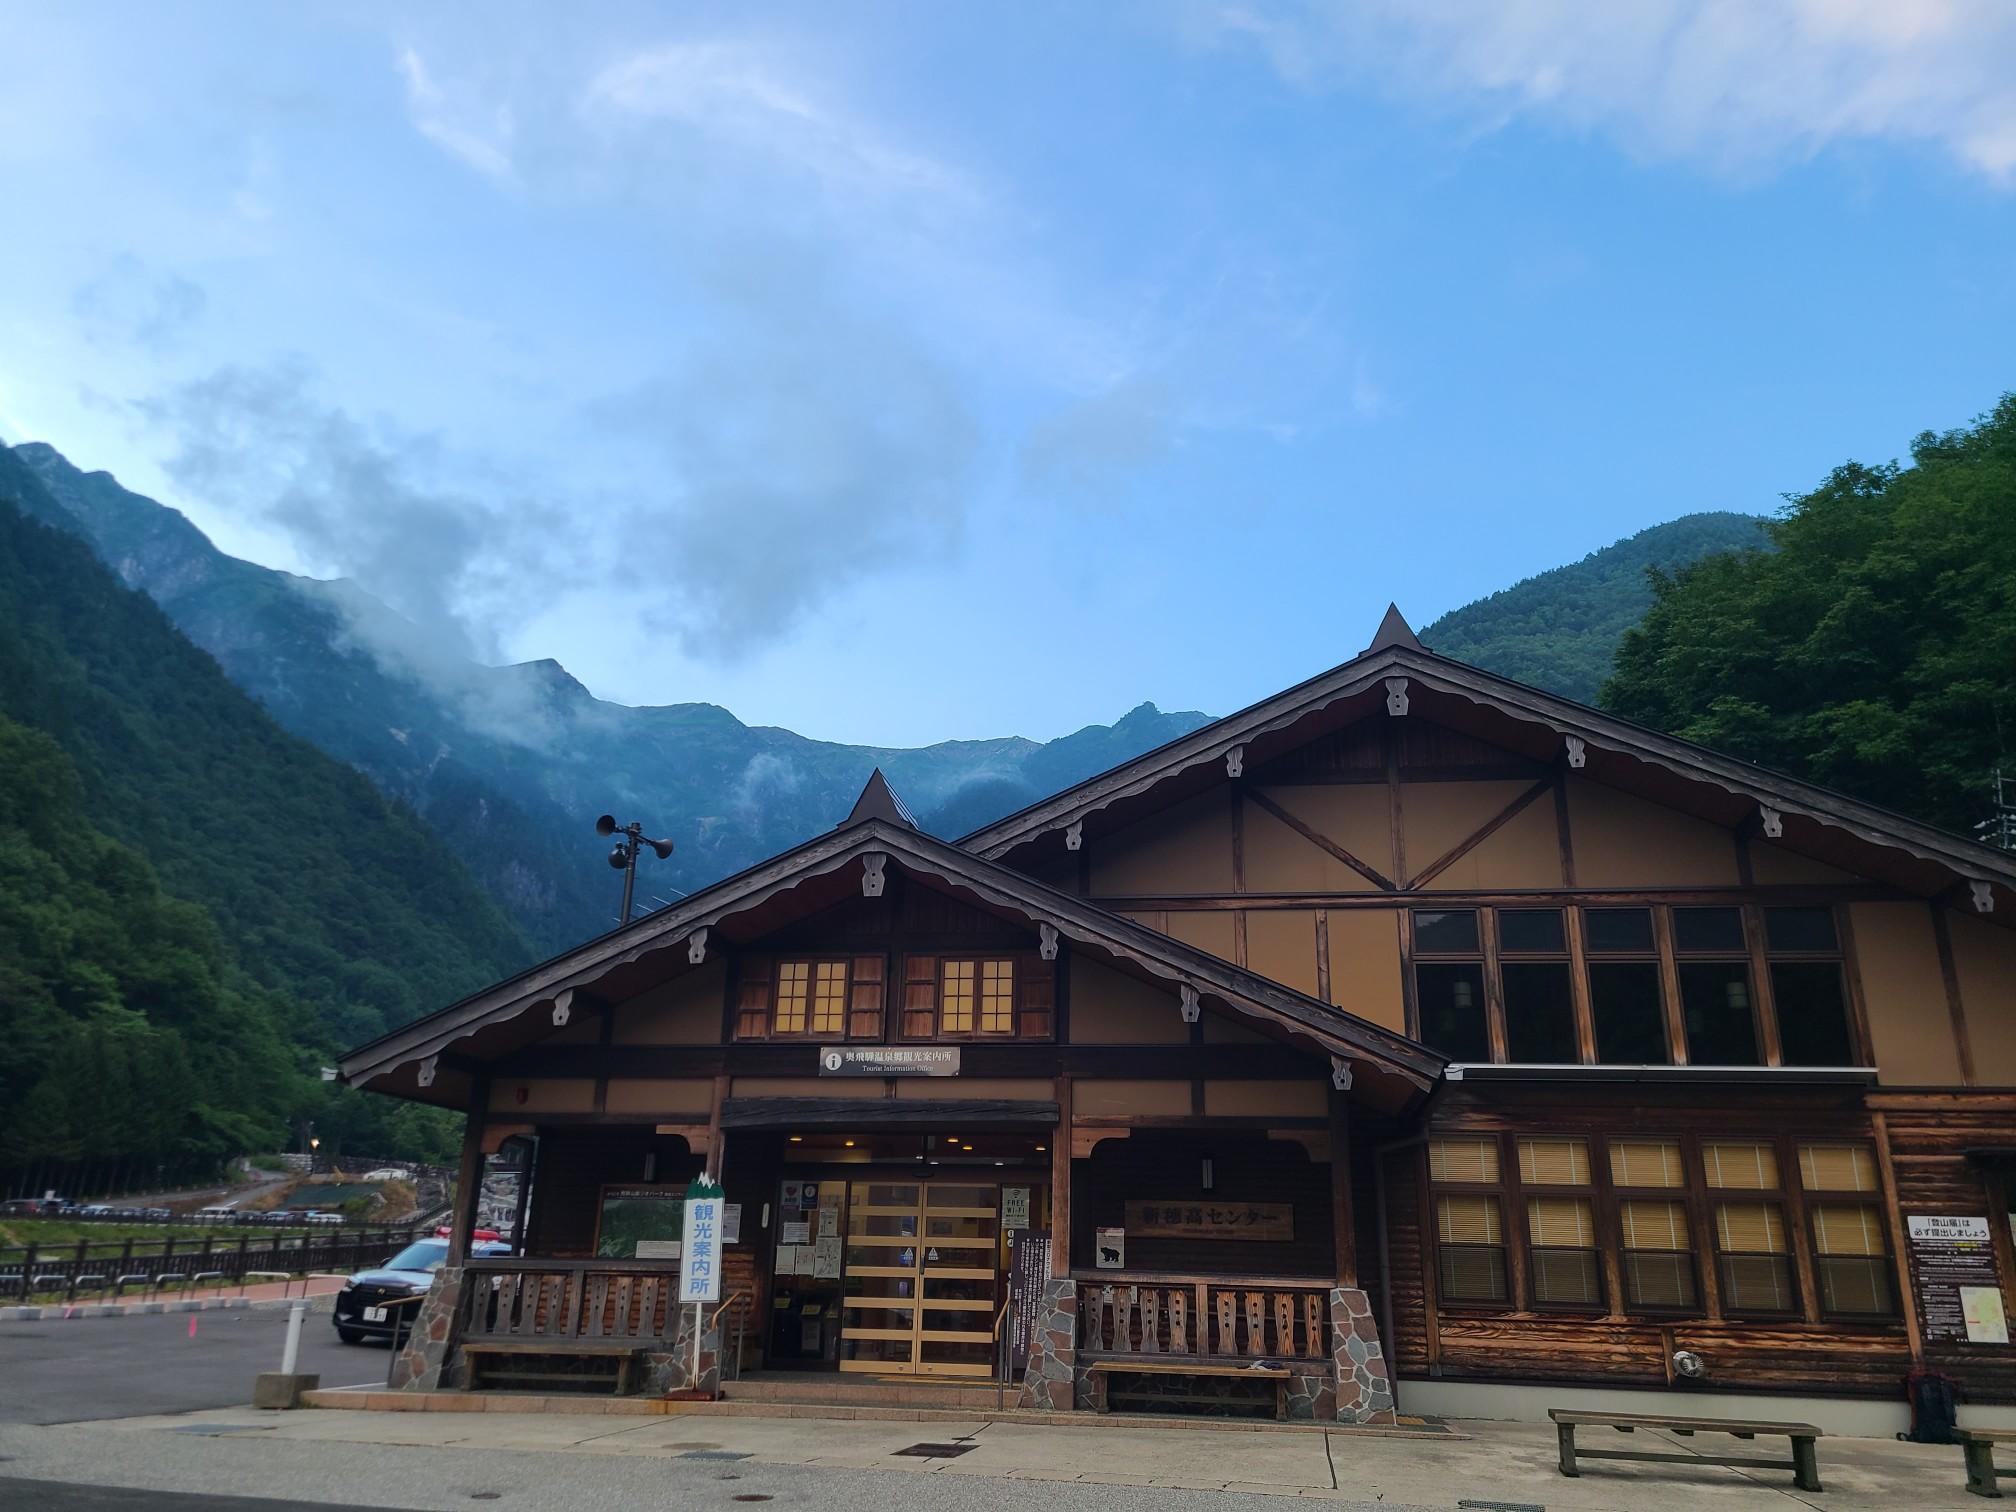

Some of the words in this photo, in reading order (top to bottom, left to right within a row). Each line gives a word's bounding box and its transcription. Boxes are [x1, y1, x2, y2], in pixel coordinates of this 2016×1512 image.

[1142, 1206, 1278, 1226] 新穂高センター
[1914, 1227, 1987, 1238] 必ず提出しましょう
[689, 1204, 714, 1294] 観光案内所
